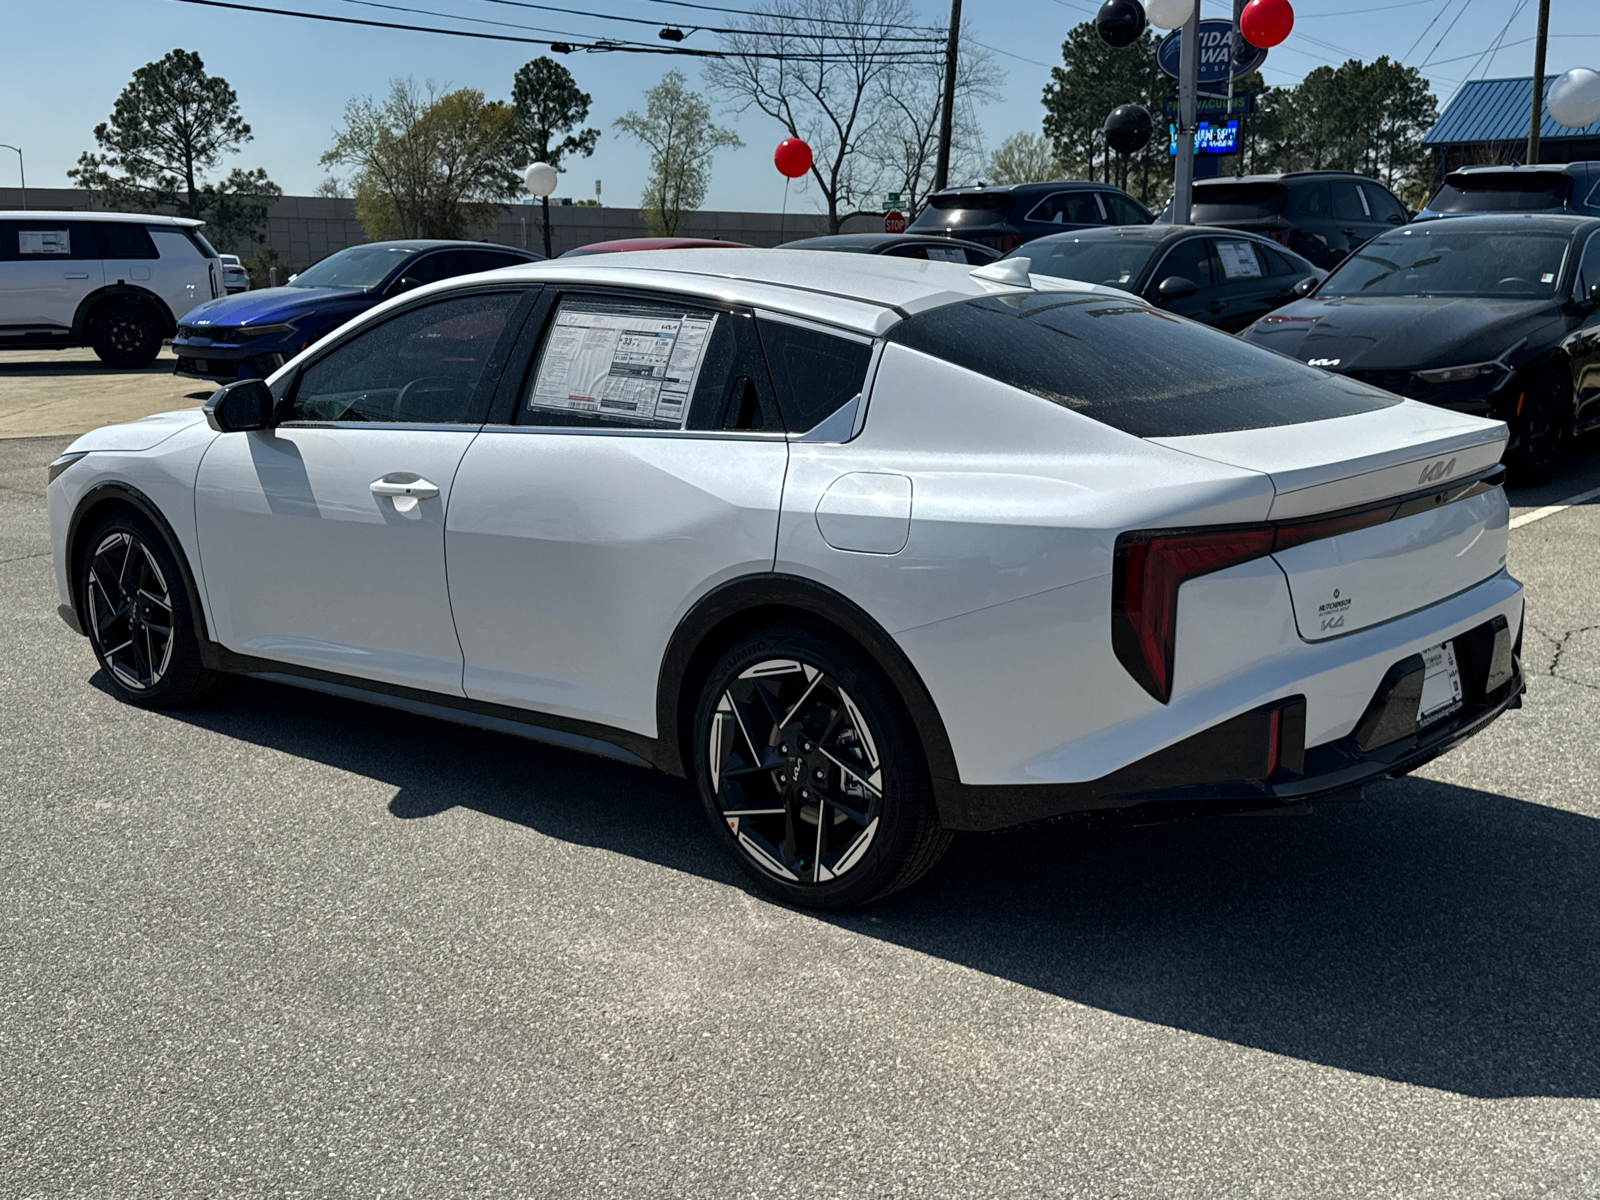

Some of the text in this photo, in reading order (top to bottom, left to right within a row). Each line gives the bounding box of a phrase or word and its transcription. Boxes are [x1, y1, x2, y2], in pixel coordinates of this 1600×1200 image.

[1201, 47, 1229, 63] WA
[885, 220, 905, 231] STOP
[623, 337, 633, 346] 33
[1307, 358, 1341, 366] KIA
[1417, 457, 1457, 485] KIA
[1318, 597, 1352, 613] HUTCHINSON
[721, 641, 767, 676] KUMHO
